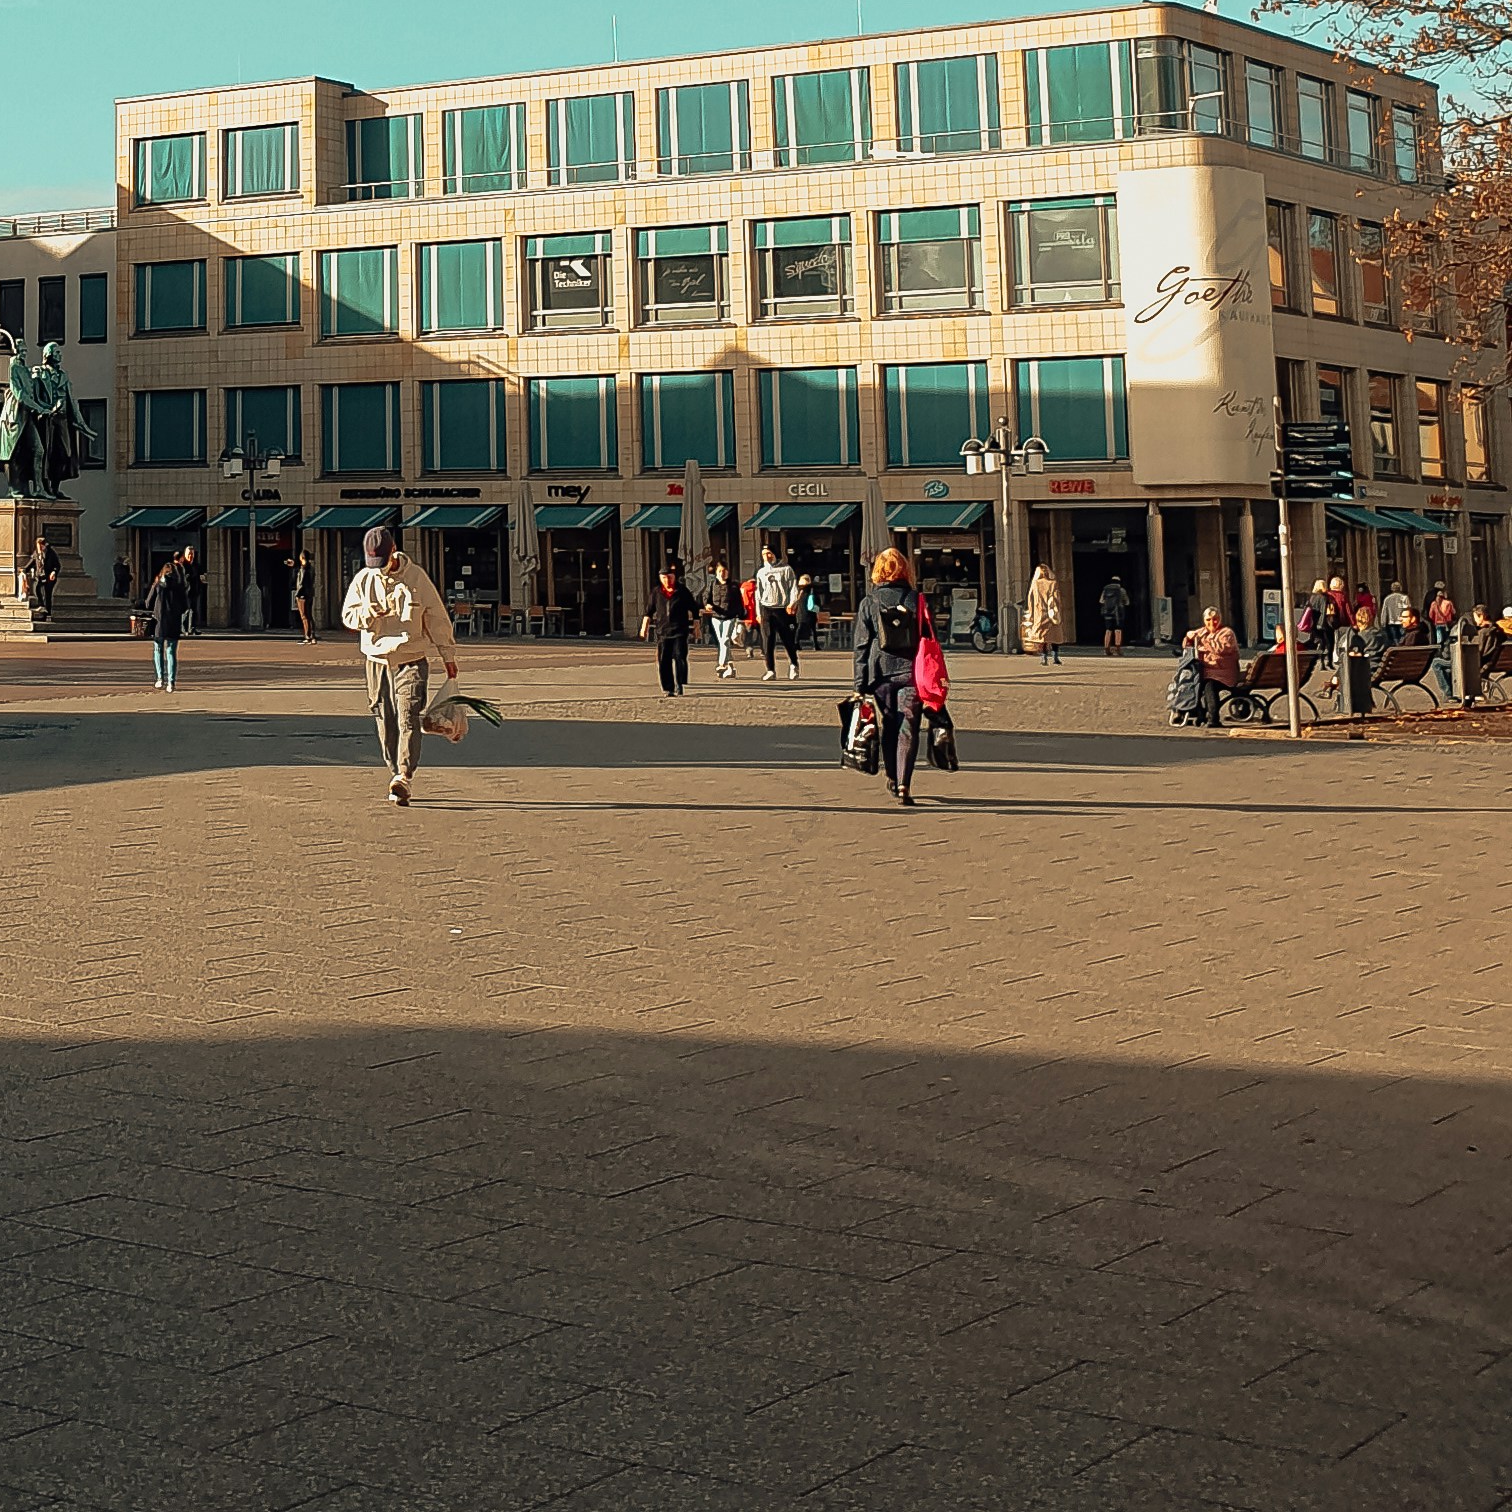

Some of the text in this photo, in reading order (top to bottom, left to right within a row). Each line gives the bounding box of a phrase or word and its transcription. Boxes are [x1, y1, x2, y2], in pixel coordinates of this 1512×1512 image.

[553, 271, 567, 279] Die
[554, 279, 592, 288] Techniker
[1134, 266, 1253, 323] Goethe
[788, 483, 829, 496] CECIL
[1049, 479, 1096, 494] REWE
[547, 485, 591, 504] mey
